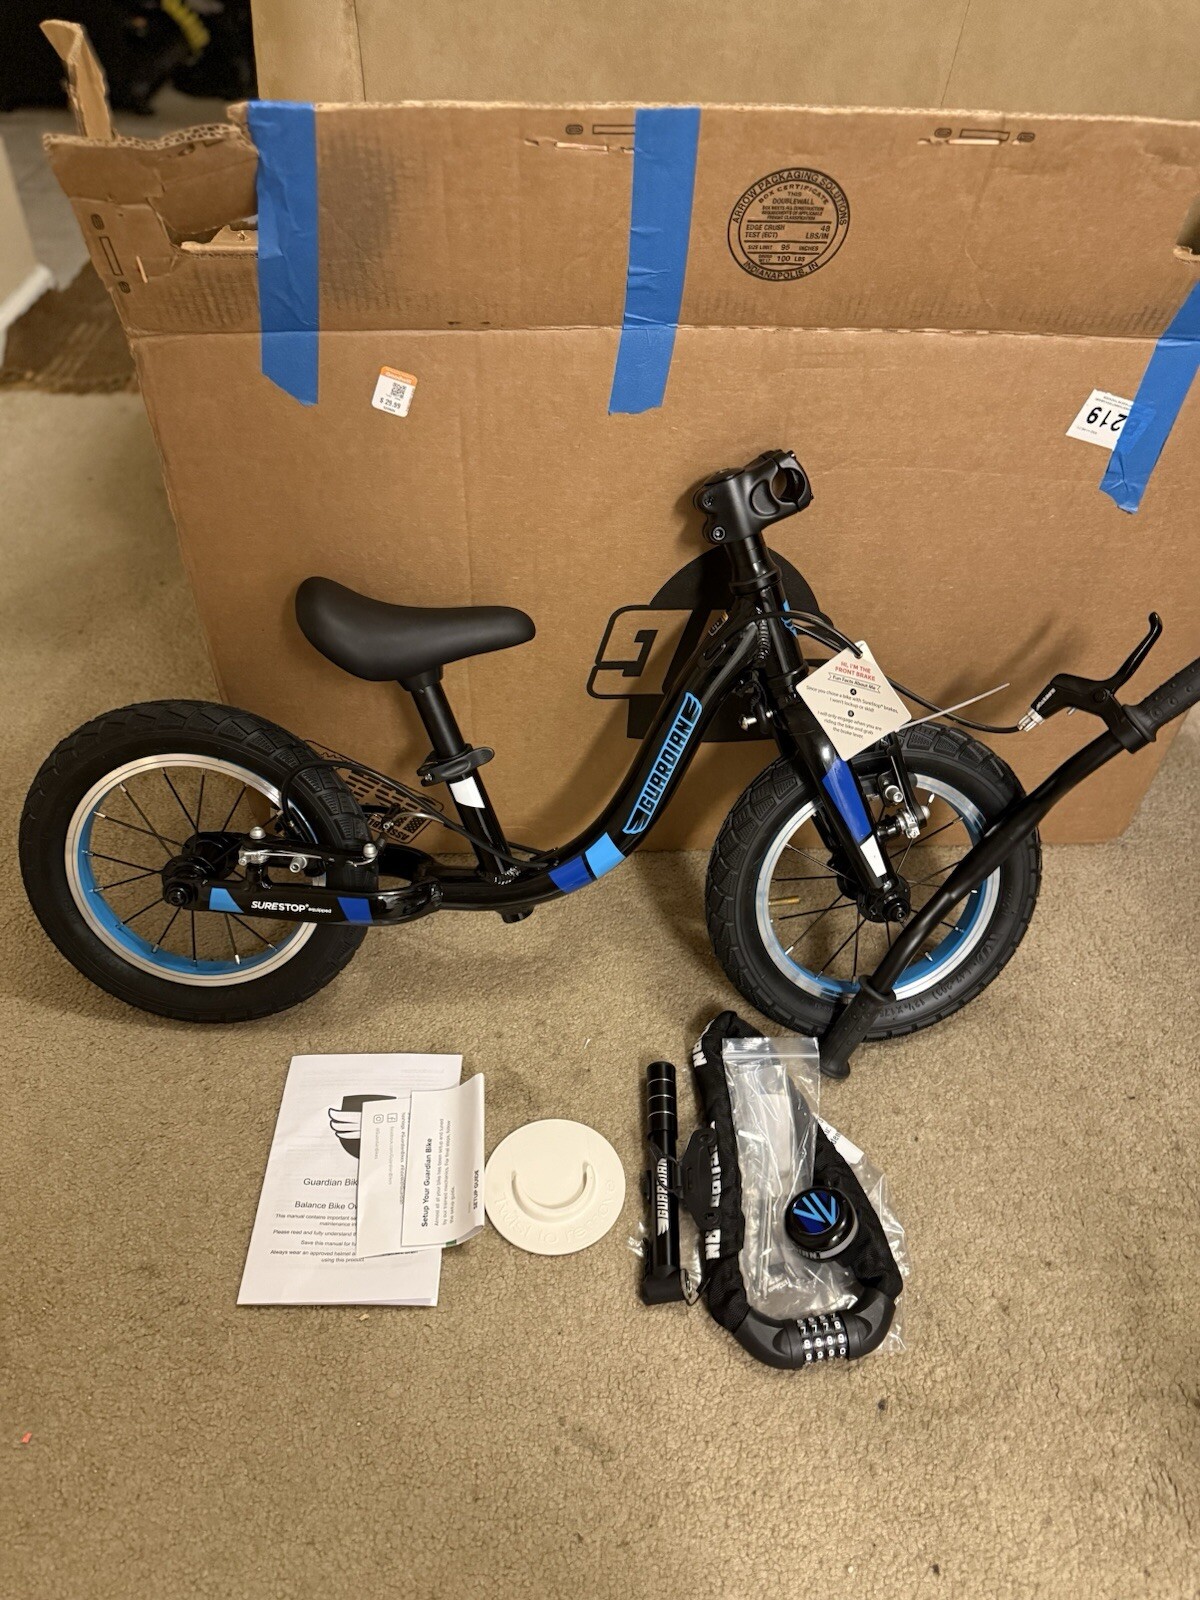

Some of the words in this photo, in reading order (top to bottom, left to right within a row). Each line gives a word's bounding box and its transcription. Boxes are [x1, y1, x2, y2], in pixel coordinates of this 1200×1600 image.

[732, 188, 757, 223] ARROW
[760, 170, 819, 190] PACKAGING
[820, 177, 848, 225] SOLUTIONS
[758, 191, 774, 203] BOX
[777, 184, 829, 205] CERTIFICATE
[762, 231, 778, 239] (ECT)
[808, 261, 819, 271] IN
[835, 666, 855, 676] FRONT
[856, 671, 877, 681] BRAKE
[859, 666, 871, 674] THE
[854, 680, 868, 688] About
[638, 717, 694, 815] GUARDIAN
[423, 1154, 432, 1186] Guardian
[303, 1178, 342, 1186] Guardian
[344, 1178, 358, 1186] Bik
[294, 1200, 326, 1209] Balance
[421, 1205, 429, 1227] Setup
